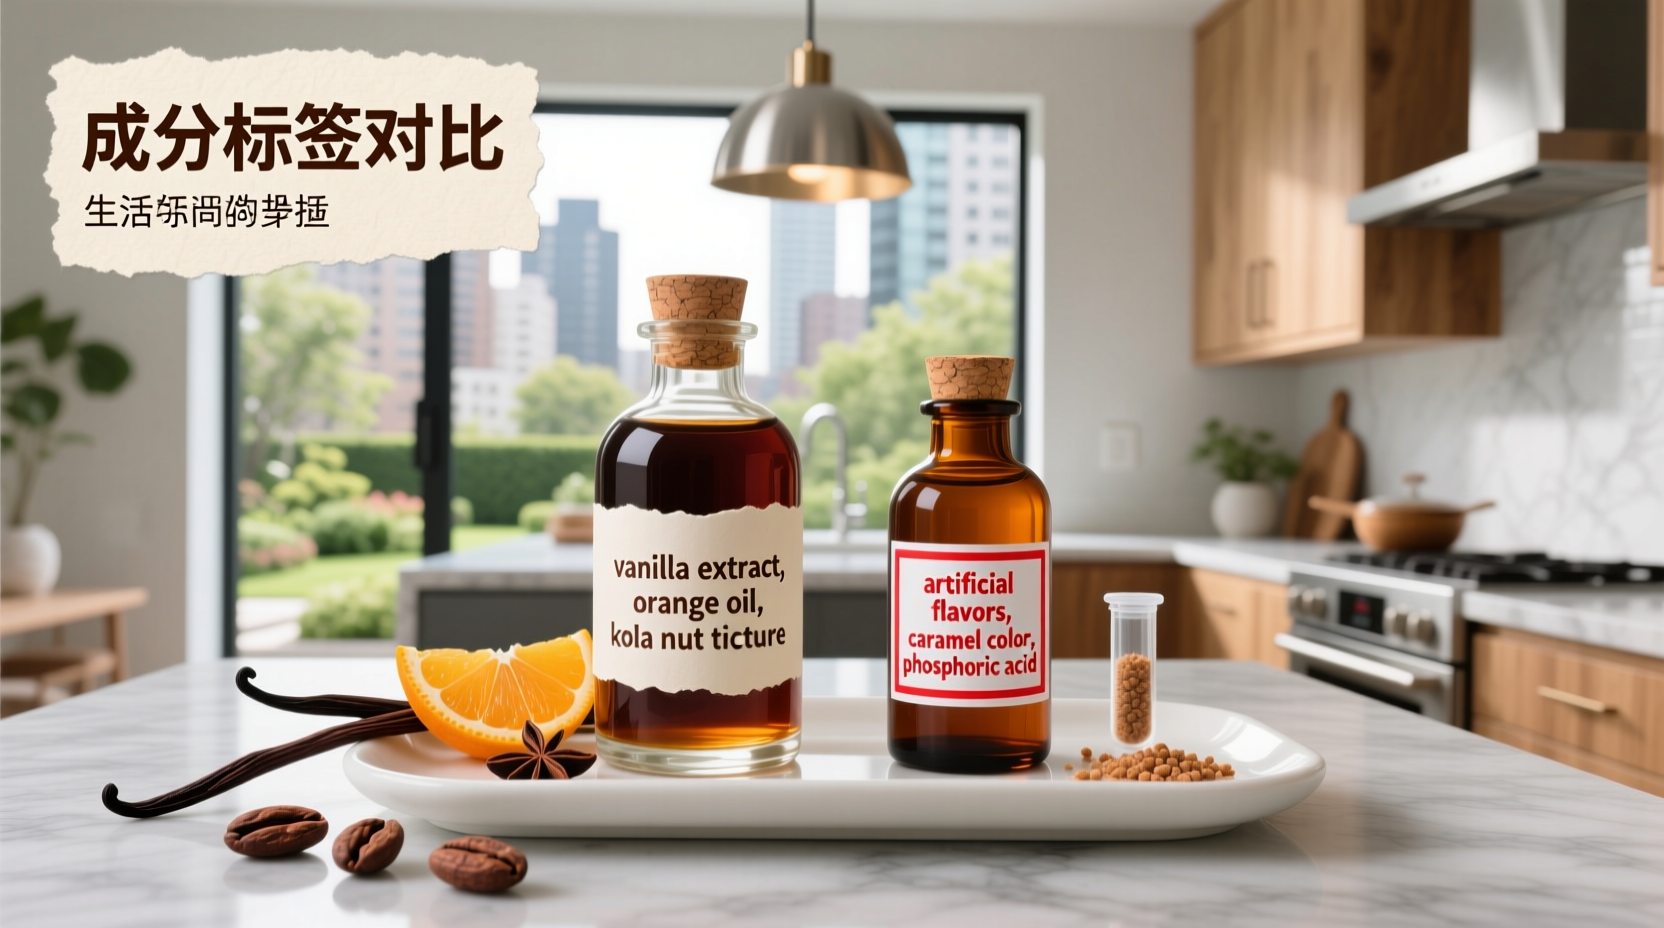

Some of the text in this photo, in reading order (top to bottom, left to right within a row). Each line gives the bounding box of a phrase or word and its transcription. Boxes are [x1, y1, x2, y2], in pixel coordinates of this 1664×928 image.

[614, 554, 785, 583] vanilla extract,
[923, 570, 1014, 595] artificial
[633, 588, 764, 622] orange oil,
[930, 598, 1012, 626] flavors,
[611, 621, 786, 651] kola nut ticture
[908, 627, 1036, 651] caramel color,
[903, 652, 1037, 681] phosphoric acid
